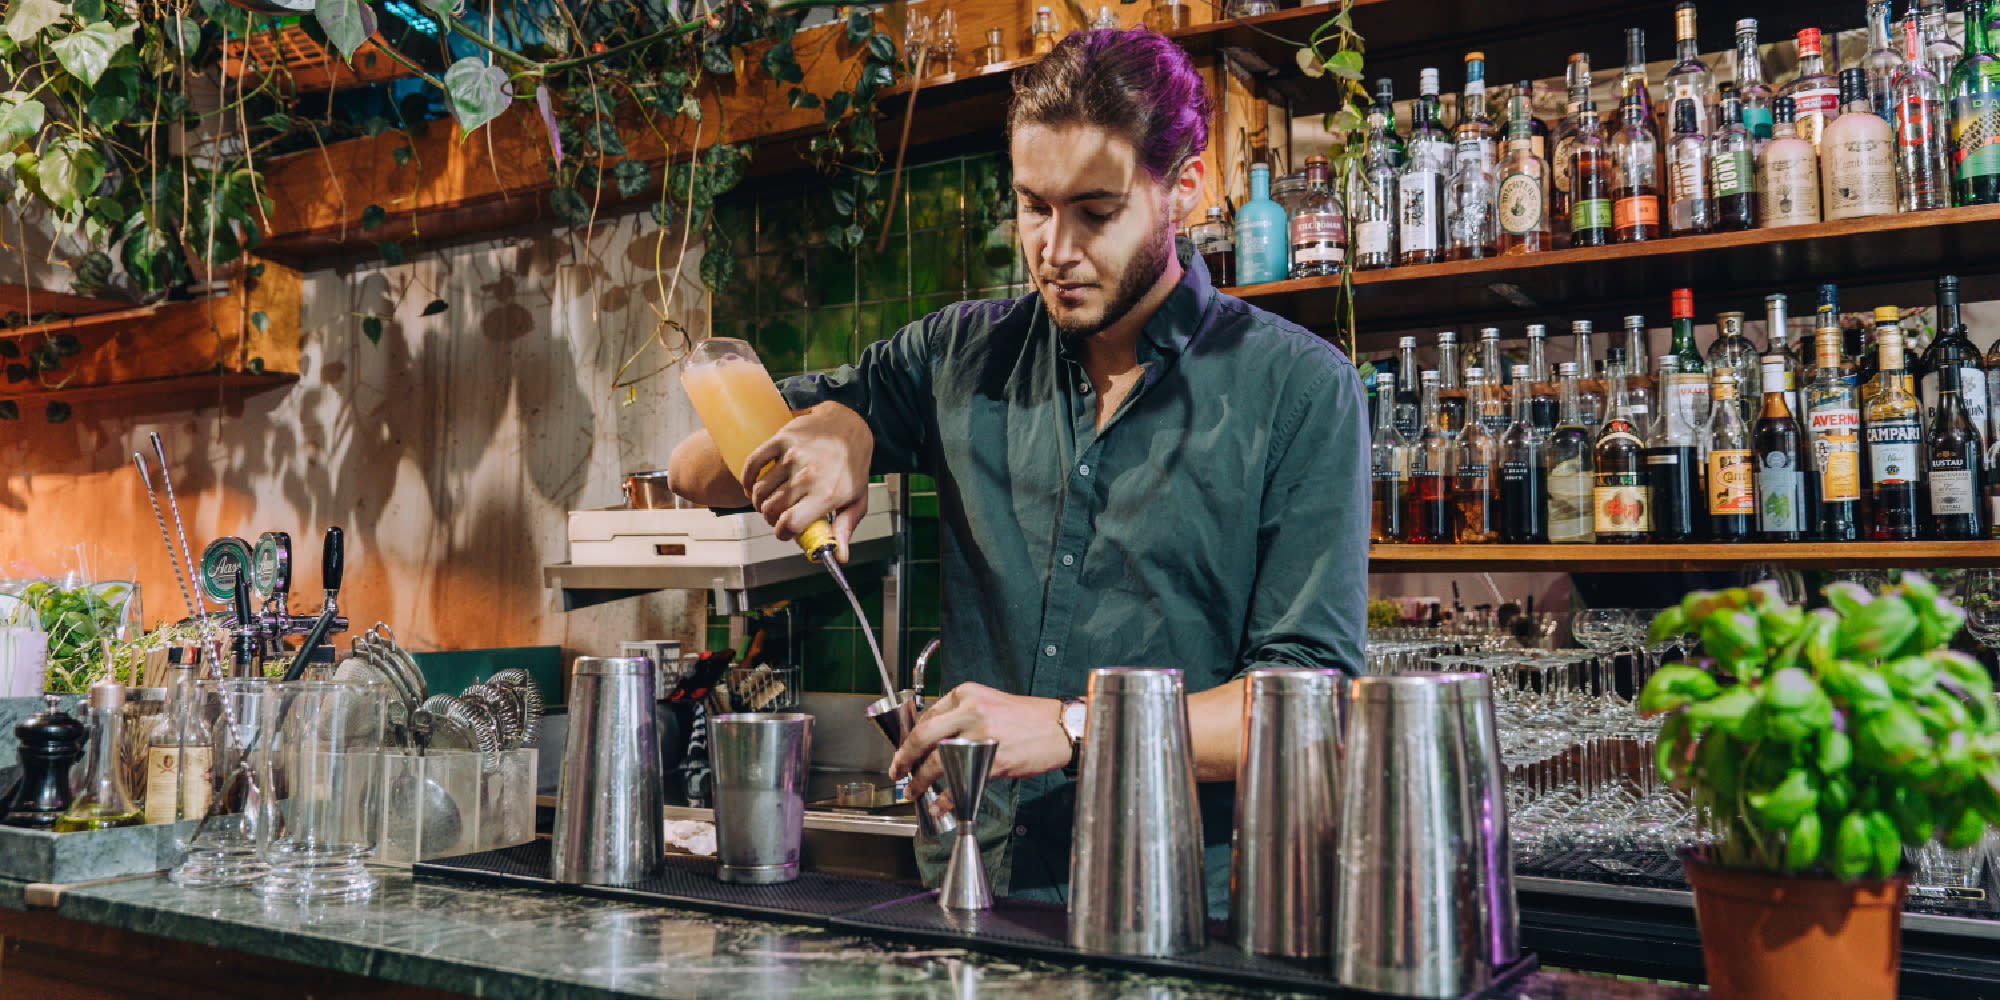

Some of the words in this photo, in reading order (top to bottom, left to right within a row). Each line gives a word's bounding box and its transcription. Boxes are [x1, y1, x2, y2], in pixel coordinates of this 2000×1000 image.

[1716, 152, 1738, 190] KNOB
[1813, 414, 1859, 427] AVERNA
[1867, 427, 1921, 442] CAMPARI
